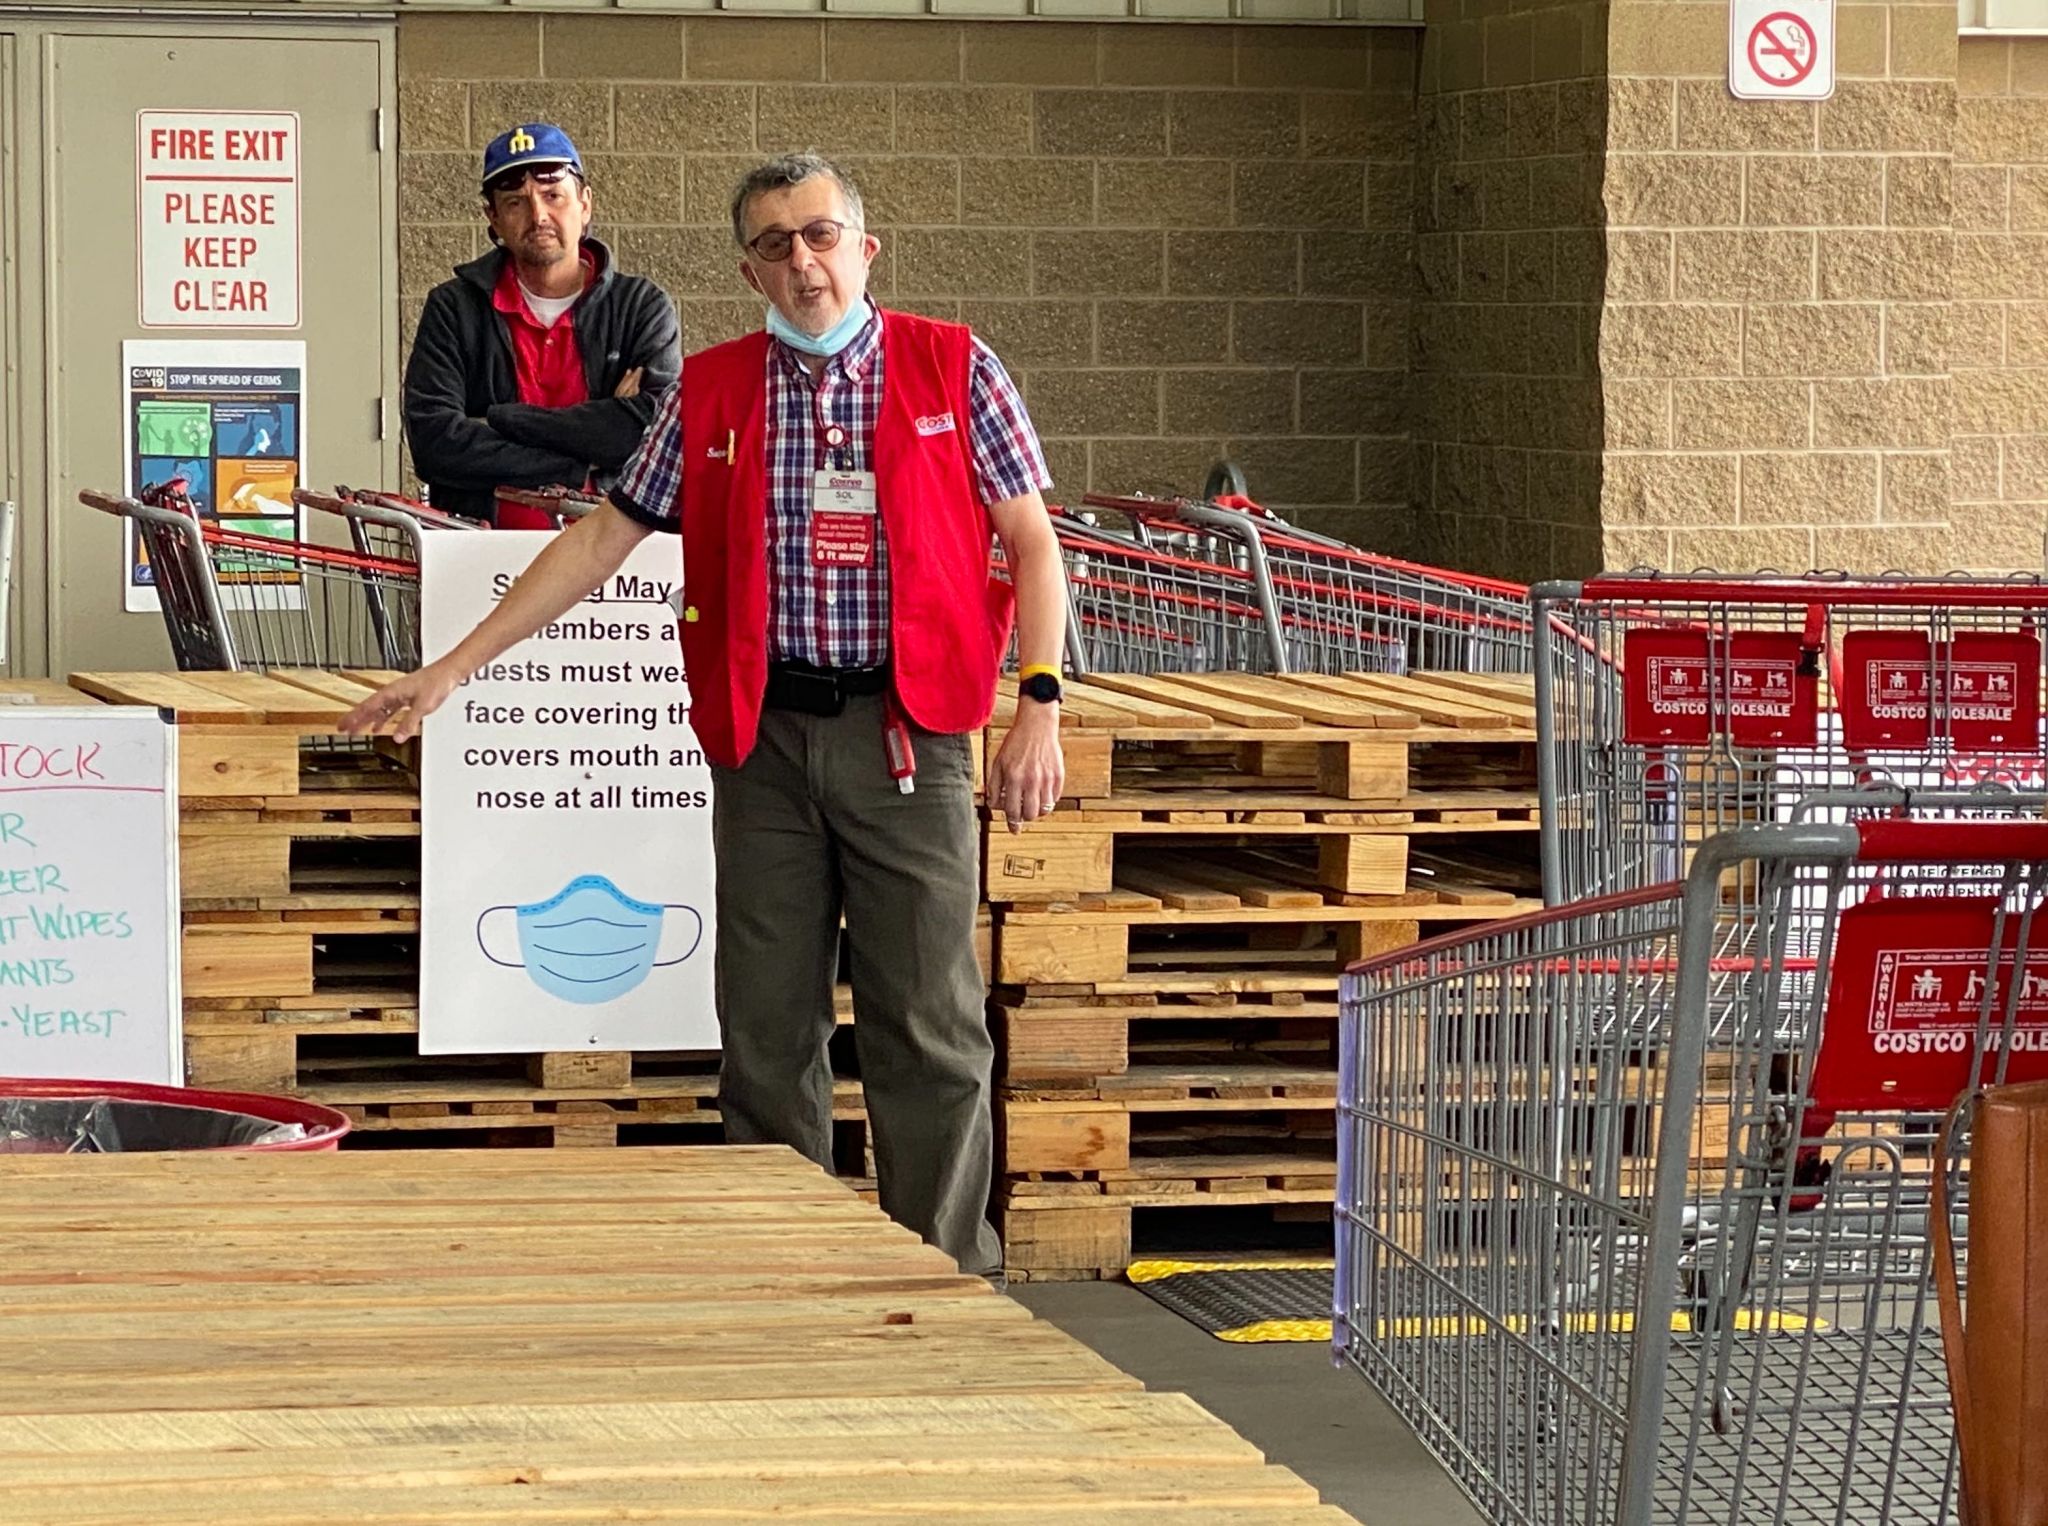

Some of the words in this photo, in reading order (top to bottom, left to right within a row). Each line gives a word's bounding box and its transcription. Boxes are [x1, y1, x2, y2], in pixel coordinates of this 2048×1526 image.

[151, 129, 214, 160] FIRE
[225, 130, 288, 161] EXIT
[165, 193, 275, 225] PLEASE
[184, 237, 257, 268] KEEP
[173, 280, 267, 311] CLEAR
[132, 368, 164, 378] COVID
[151, 377, 164, 388] 19
[169, 374, 191, 385] STOP
[192, 374, 207, 386] THE
[208, 374, 240, 386] SPREAD
[241, 375, 252, 386] OF
[253, 375, 282, 386] GERMS
[835, 491, 854, 500] SOL
[816, 540, 848, 551] Please
[849, 542, 870, 554] stay
[816, 550, 825, 560] 6
[838, 552, 867, 563] away
[615, 575, 672, 604] May
[561, 661, 633, 683] must
[464, 700, 525, 725] face
[534, 702, 658, 731] covering
[1653, 702, 1707, 715] COSTCO
[1872, 706, 1927, 719] COSTCO
[463, 748, 560, 767] covers
[569, 744, 659, 767] mouth
[476, 790, 546, 809] nose
[554, 786, 582, 809] at
[590, 785, 622, 809] all
[631, 786, 708, 809] times
[29, 902, 134, 941] WIPES
[1874, 964, 1893, 1030] WARNING
[1874, 1031, 1967, 1053] COSTCO
